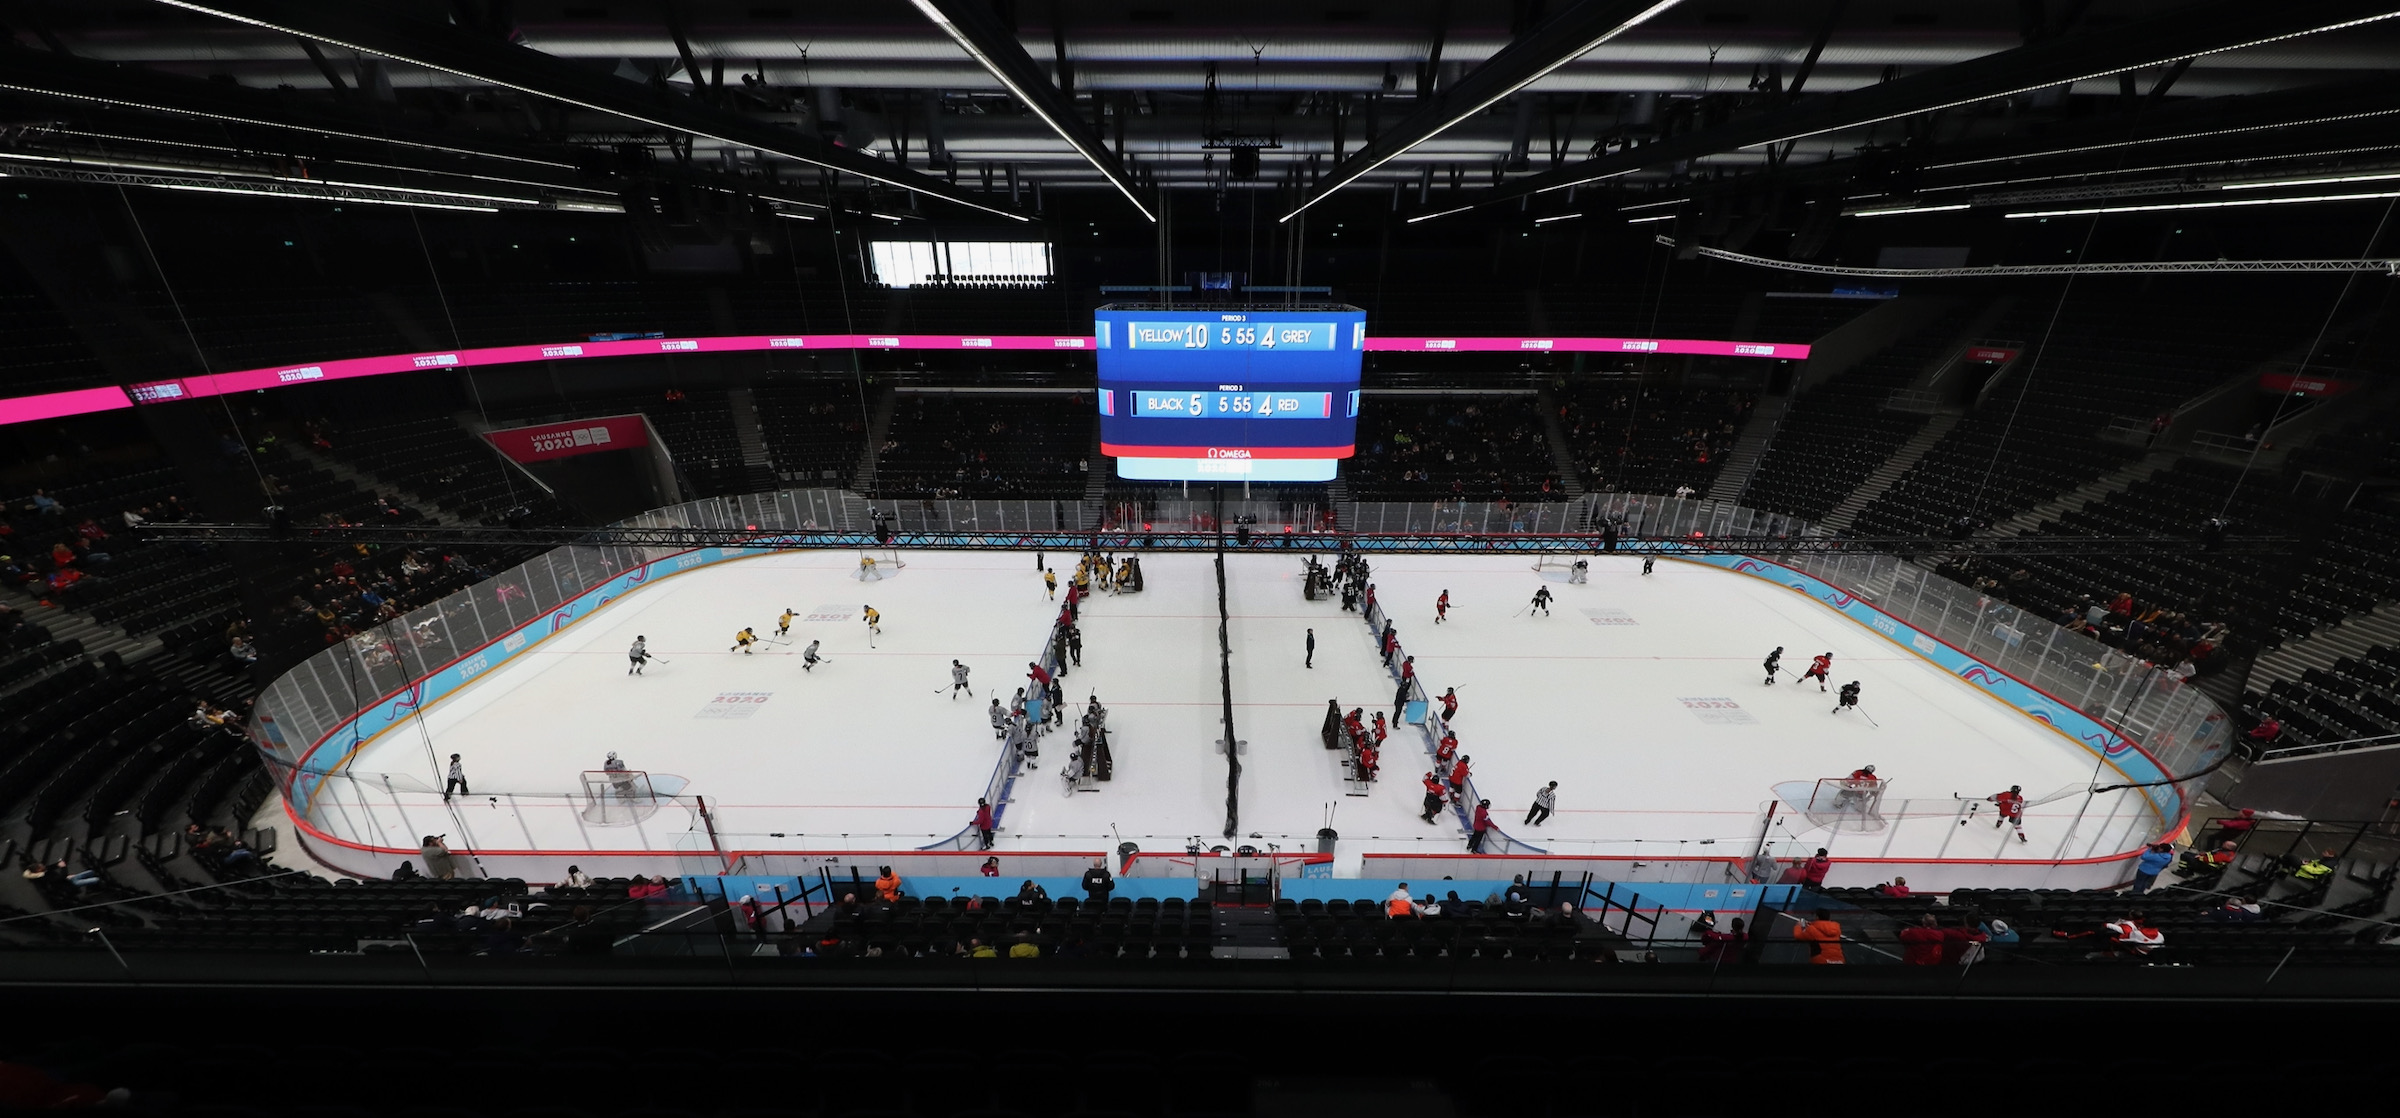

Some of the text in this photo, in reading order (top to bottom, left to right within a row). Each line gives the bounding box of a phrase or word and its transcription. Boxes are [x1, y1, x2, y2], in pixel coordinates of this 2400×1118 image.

[1138, 324, 1312, 348] YELLOW 10 5 55 4 GREY
[280, 373, 301, 382] 2020
[1148, 394, 1299, 416] BLACK 5 5 55 4 RED
[531, 431, 571, 442] LAUSANNE
[534, 438, 574, 452] 2020
[1219, 450, 1251, 458] OMEGA
[678, 557, 702, 568] 2020
[1872, 619, 1895, 635] 2020
[460, 660, 488, 679] 2020
[2011, 803, 2020, 813] 6
